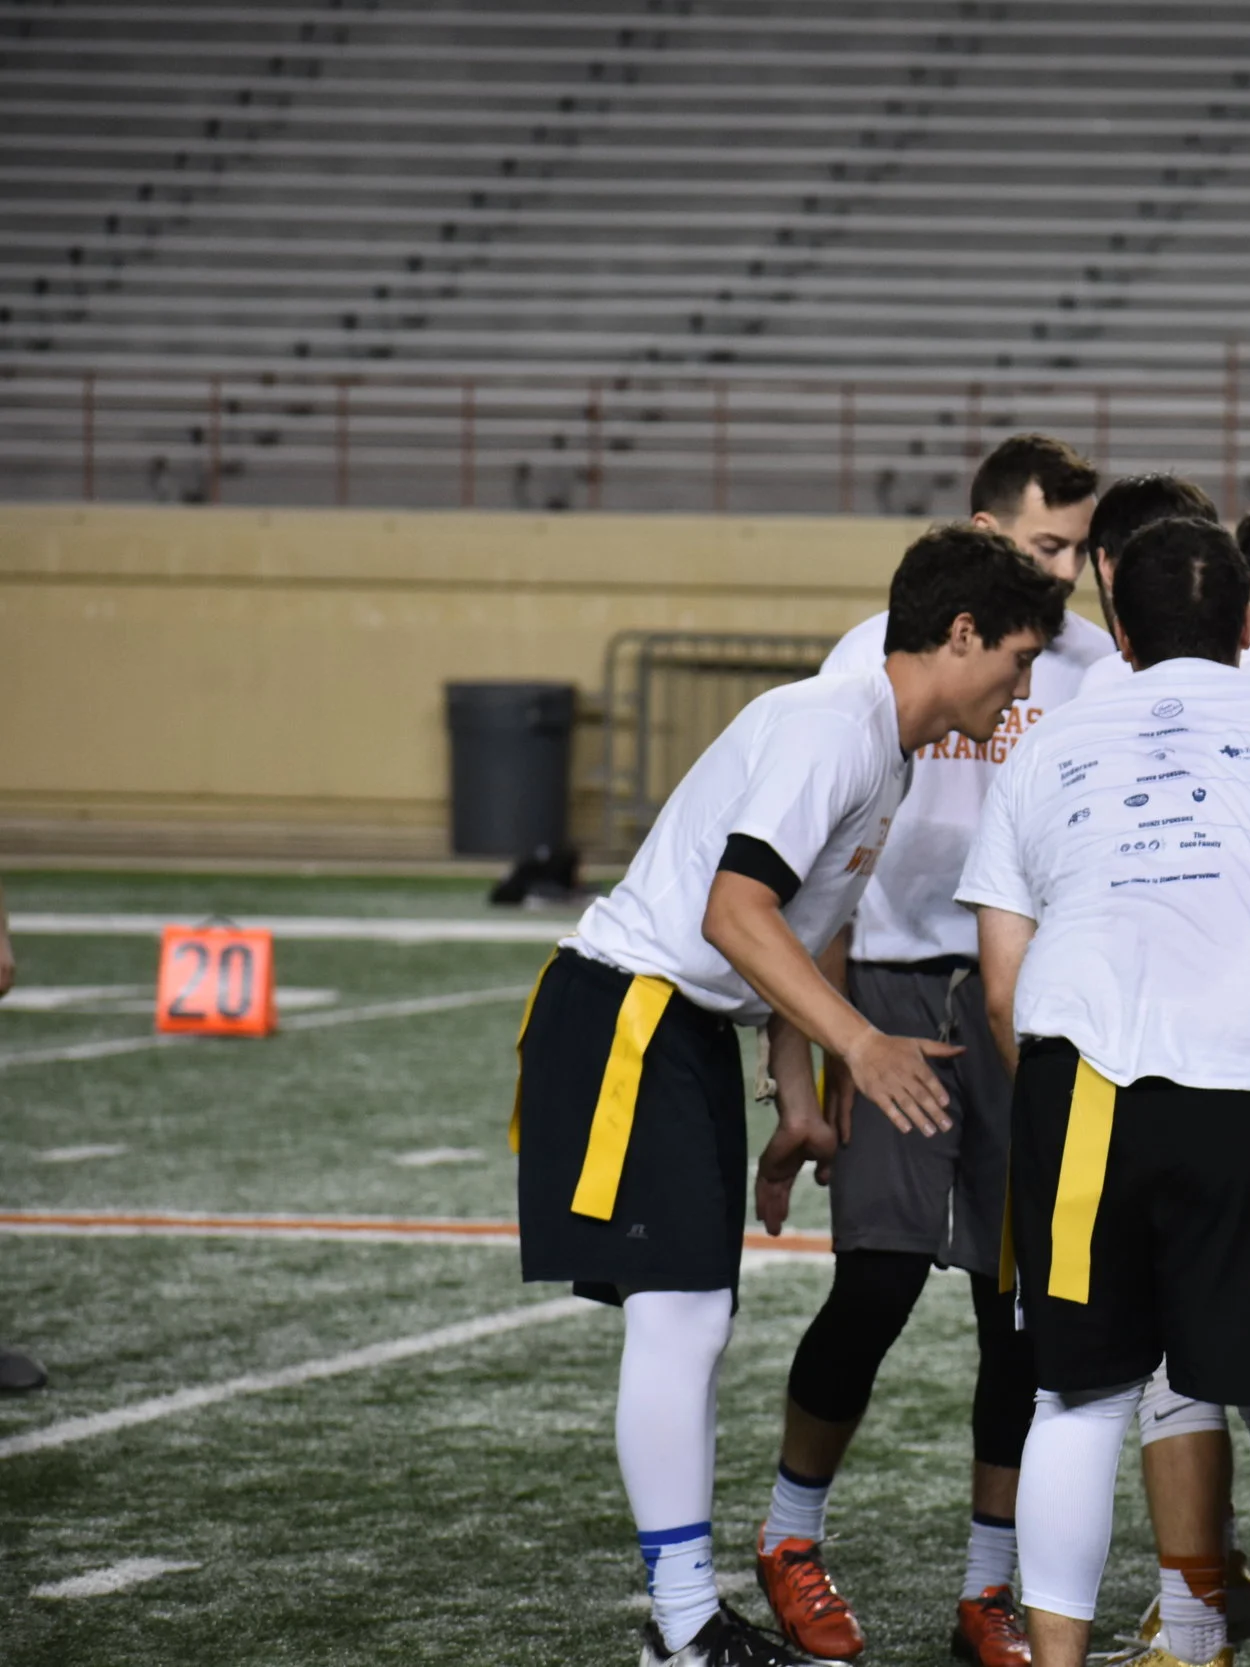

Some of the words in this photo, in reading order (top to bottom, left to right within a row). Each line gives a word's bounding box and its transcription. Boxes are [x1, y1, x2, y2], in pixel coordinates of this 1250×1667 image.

[916, 735, 1019, 765] RANG
[1193, 831, 1207, 839] The
[168, 941, 253, 1018] 20
